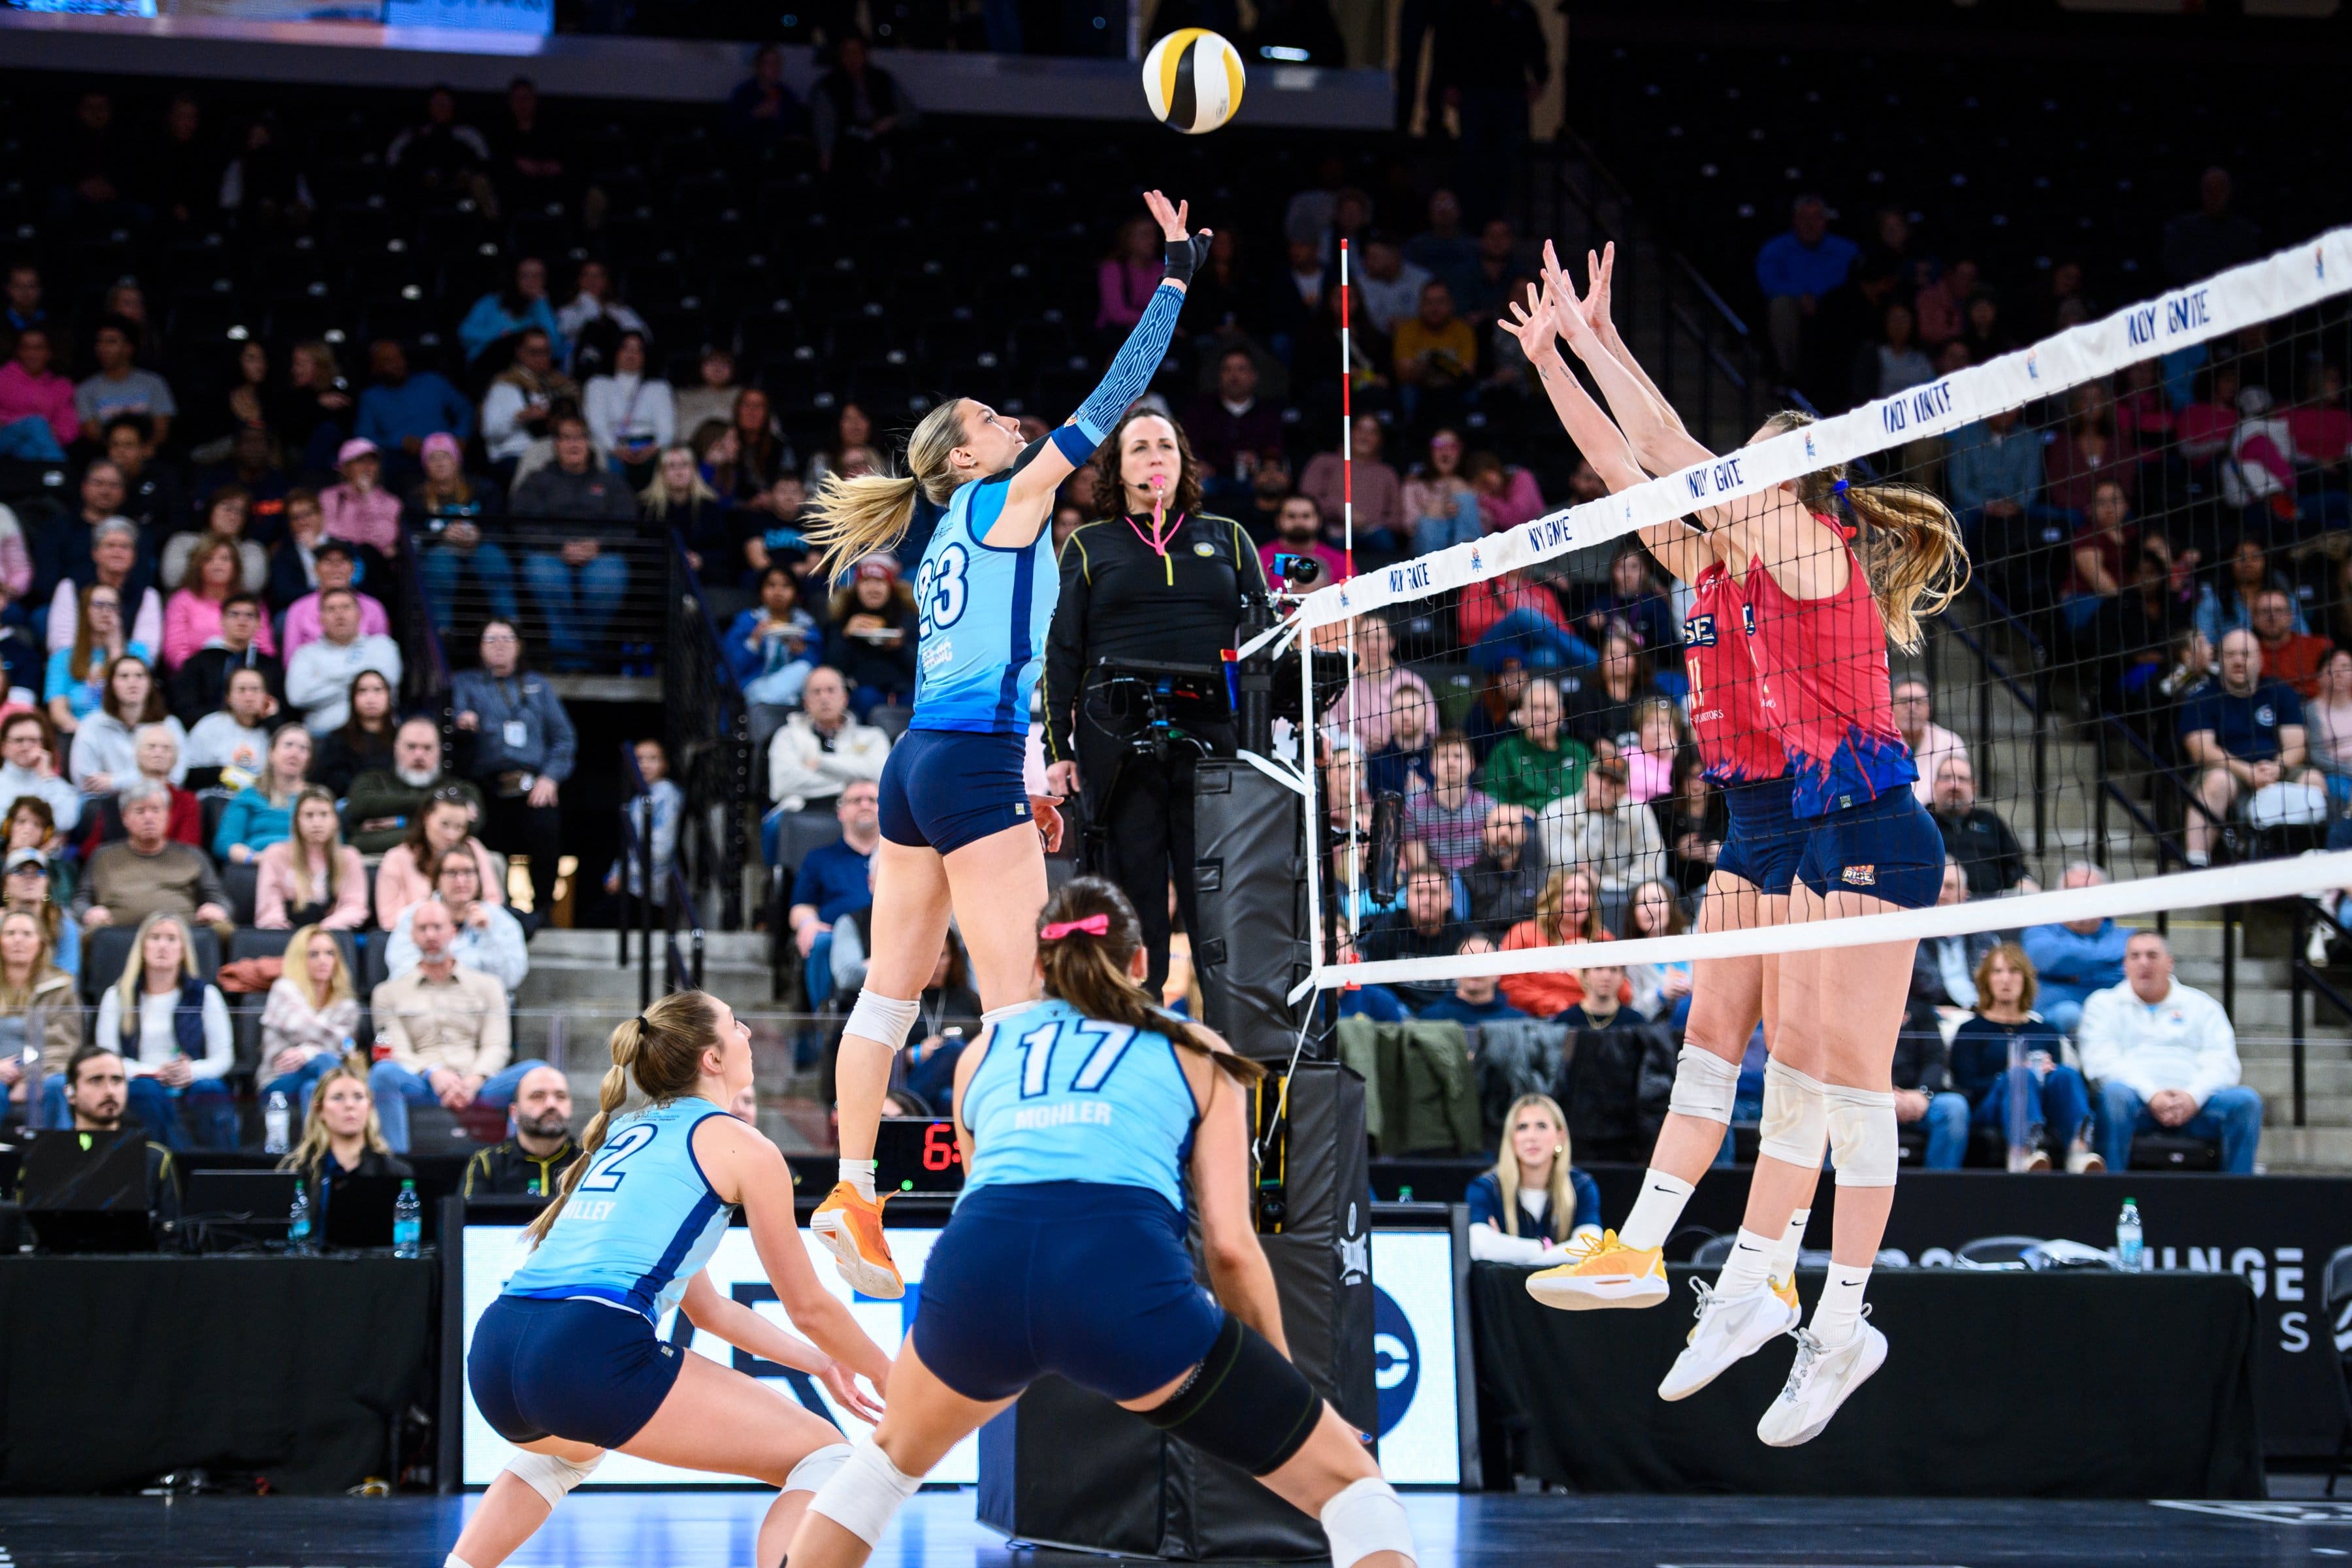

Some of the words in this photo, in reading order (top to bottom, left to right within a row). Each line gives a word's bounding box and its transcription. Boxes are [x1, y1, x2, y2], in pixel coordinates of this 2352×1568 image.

[1015, 1017, 1141, 1102] 17
[1015, 1100, 1112, 1129] MOHLER
[578, 1122, 659, 1193] 2
